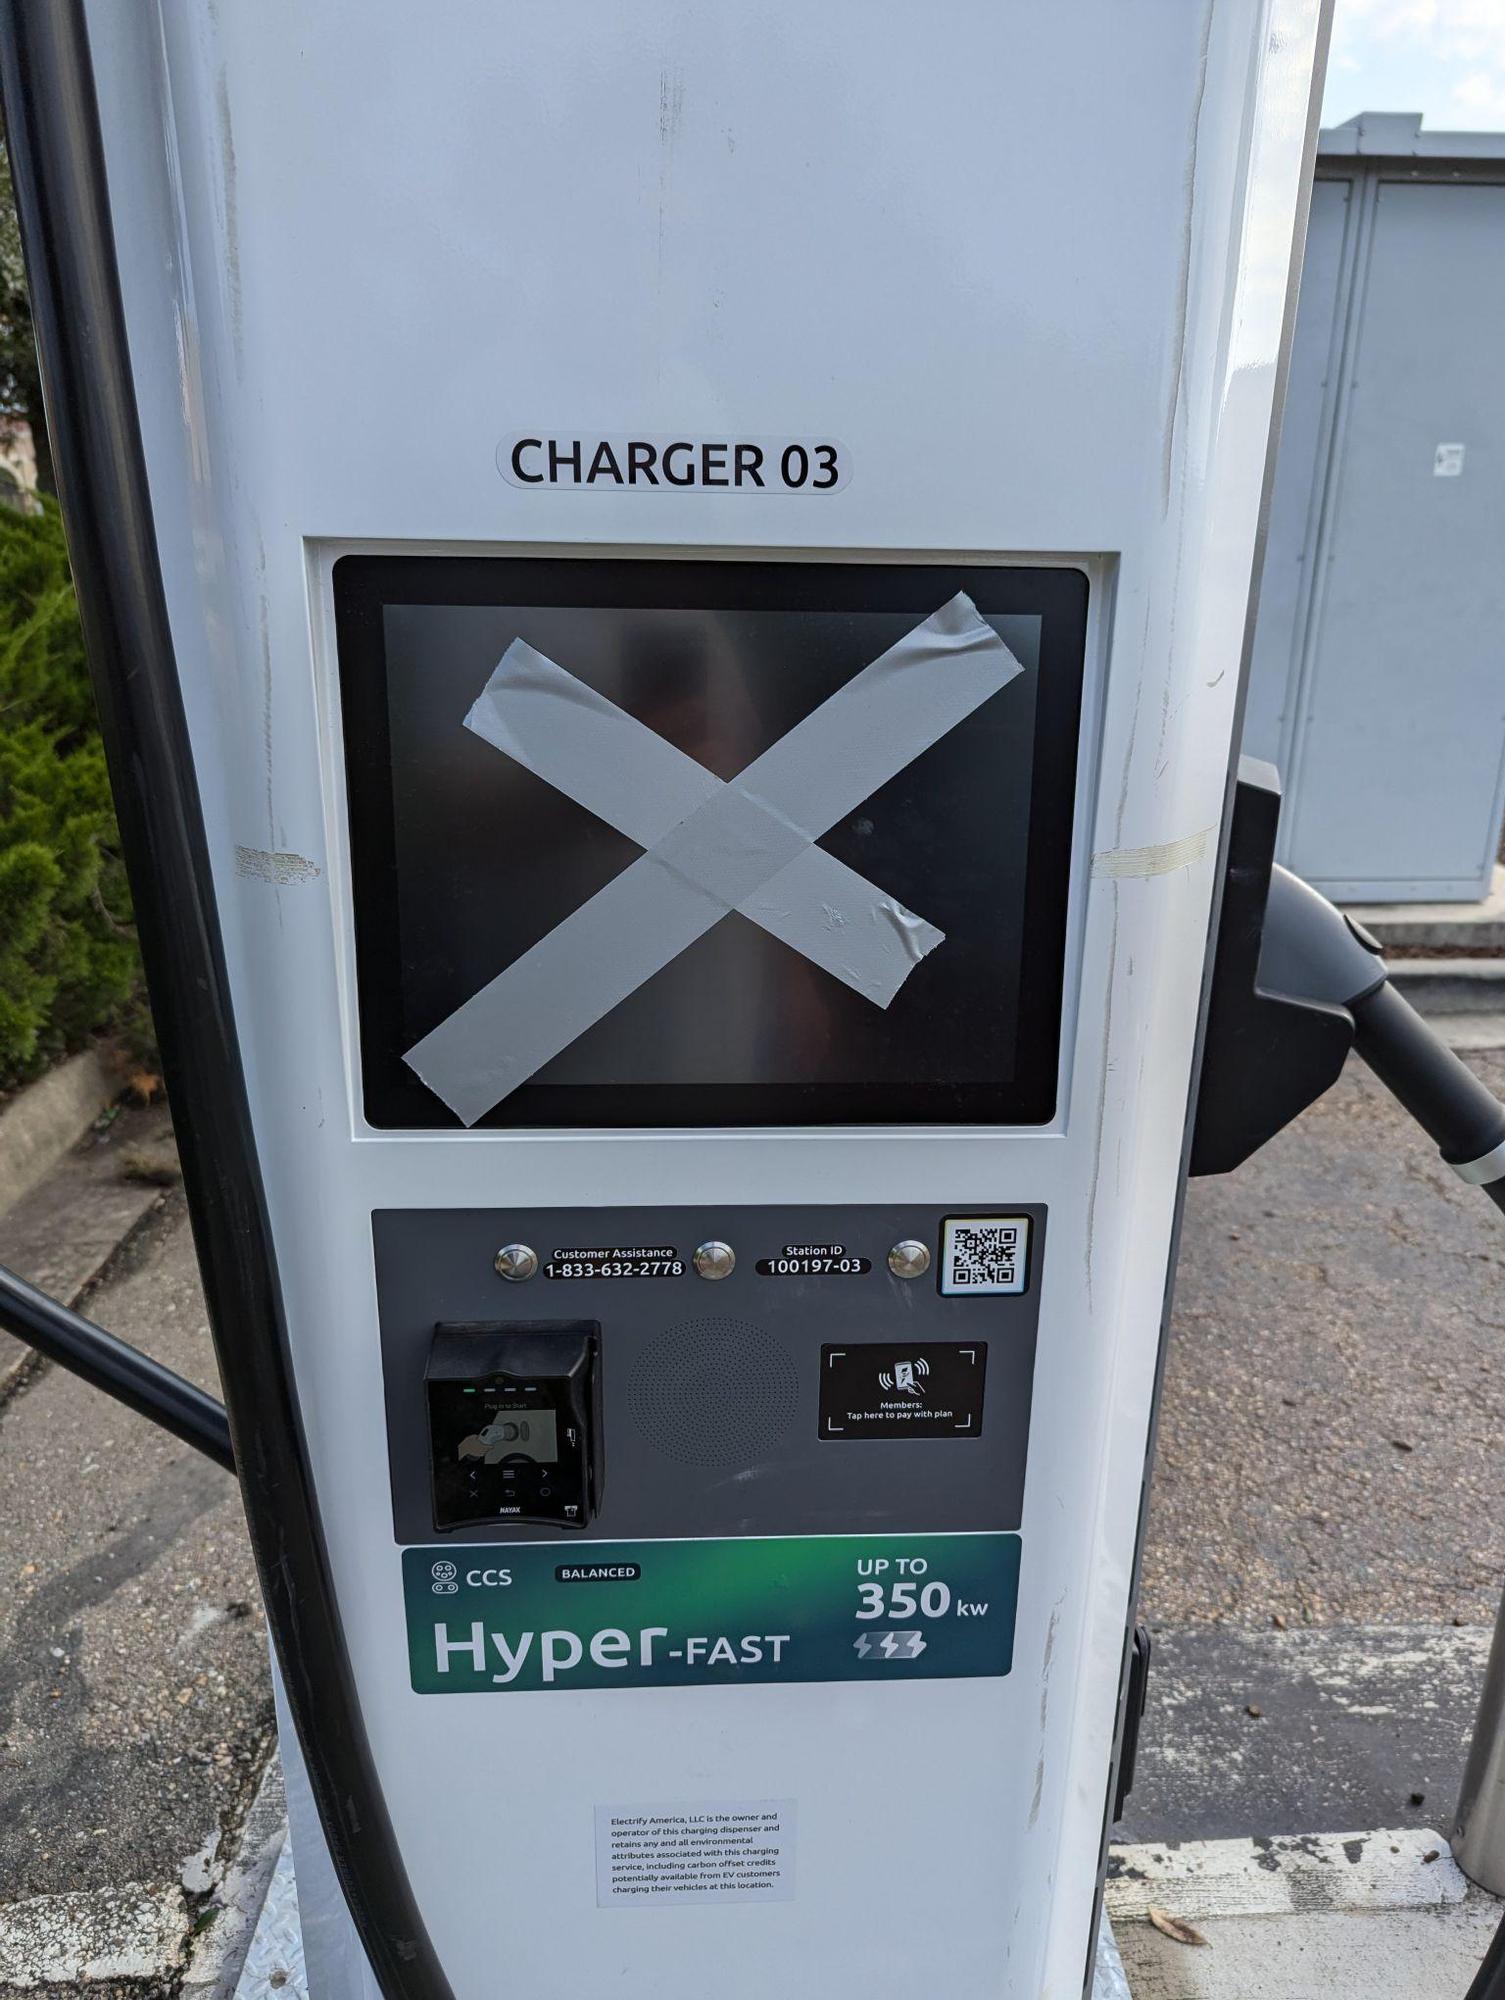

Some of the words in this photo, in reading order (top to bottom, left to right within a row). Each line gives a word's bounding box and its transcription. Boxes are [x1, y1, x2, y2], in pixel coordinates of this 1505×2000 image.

[511, 438, 766, 487] CHARGER
[780, 444, 839, 488] 03
[554, 1249, 610, 1259] Customer
[612, 1248, 673, 1258] Assistance
[786, 1246, 827, 1256] Station
[830, 1246, 843, 1255] ID
[545, 1261, 682, 1278] 1-833-632-2778
[767, 1259, 861, 1273] 100197-03
[880, 1401, 923, 1409] Members:
[847, 1412, 862, 1420] Tap
[897, 1412, 912, 1420] pay
[914, 1410, 933, 1418] with
[934, 1410, 953, 1419] plan
[500, 1506, 520, 1514] NAYAX
[561, 1566, 636, 1580] BALANCED
[857, 1559, 889, 1575] UP
[895, 1558, 928, 1575] TO
[466, 1569, 513, 1587] CCS
[855, 1581, 951, 1619] 350
[611, 1817, 647, 1826] Electrify
[649, 1816, 687, 1824] America,
[689, 1815, 704, 1823] LLC
[611, 1829, 650, 1838] operator
[680, 1827, 718, 1835] charging
[763, 1824, 780, 1832] and
[690, 1837, 753, 1846] environmental
[611, 1852, 654, 1860] attributes
[656, 1850, 701, 1858] associated
[742, 1848, 779, 1856] charging
[646, 1862, 685, 1870] including
[612, 1874, 658, 1883] potentially
[660, 1872, 698, 1881] available
[736, 1870, 781, 1878] customers
[612, 1886, 649, 1894] charging
[673, 1883, 707, 1891] vehicles
[737, 1881, 774, 1889] location.
